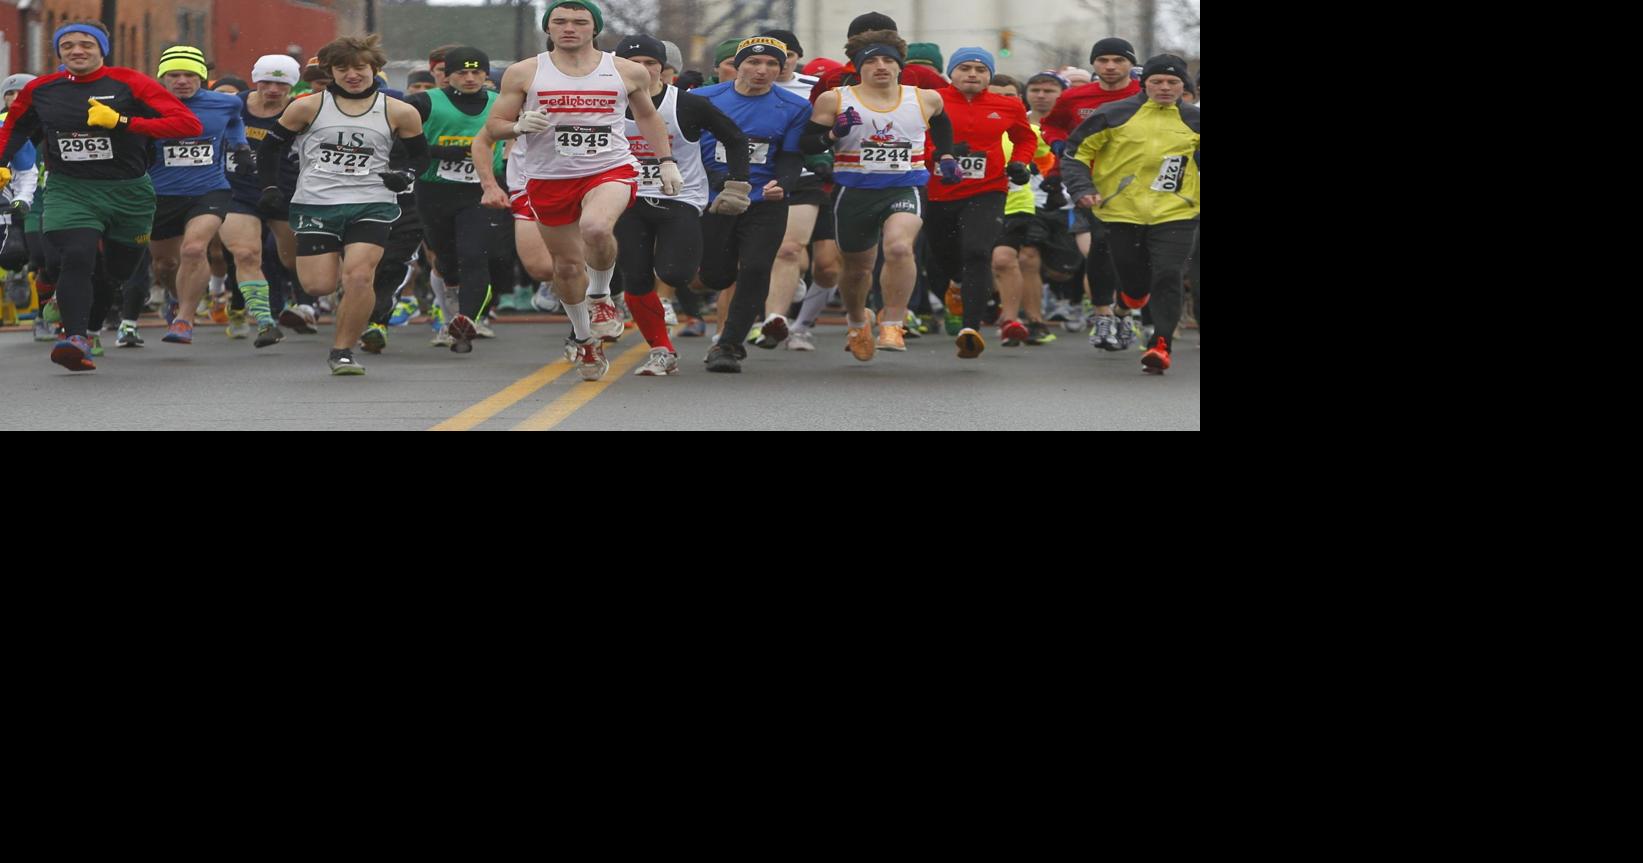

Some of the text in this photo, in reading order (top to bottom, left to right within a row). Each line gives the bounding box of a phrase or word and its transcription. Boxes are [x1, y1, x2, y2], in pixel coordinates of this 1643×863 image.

[548, 96, 608, 107] edinboro
[60, 138, 109, 152] 2963
[557, 133, 609, 147] 4945
[167, 146, 210, 158] 1267
[320, 150, 369, 168] 3727
[863, 149, 909, 161] 2244
[441, 160, 475, 174] 370
[961, 158, 983, 170] 06
[1162, 158, 1180, 190] 1270
